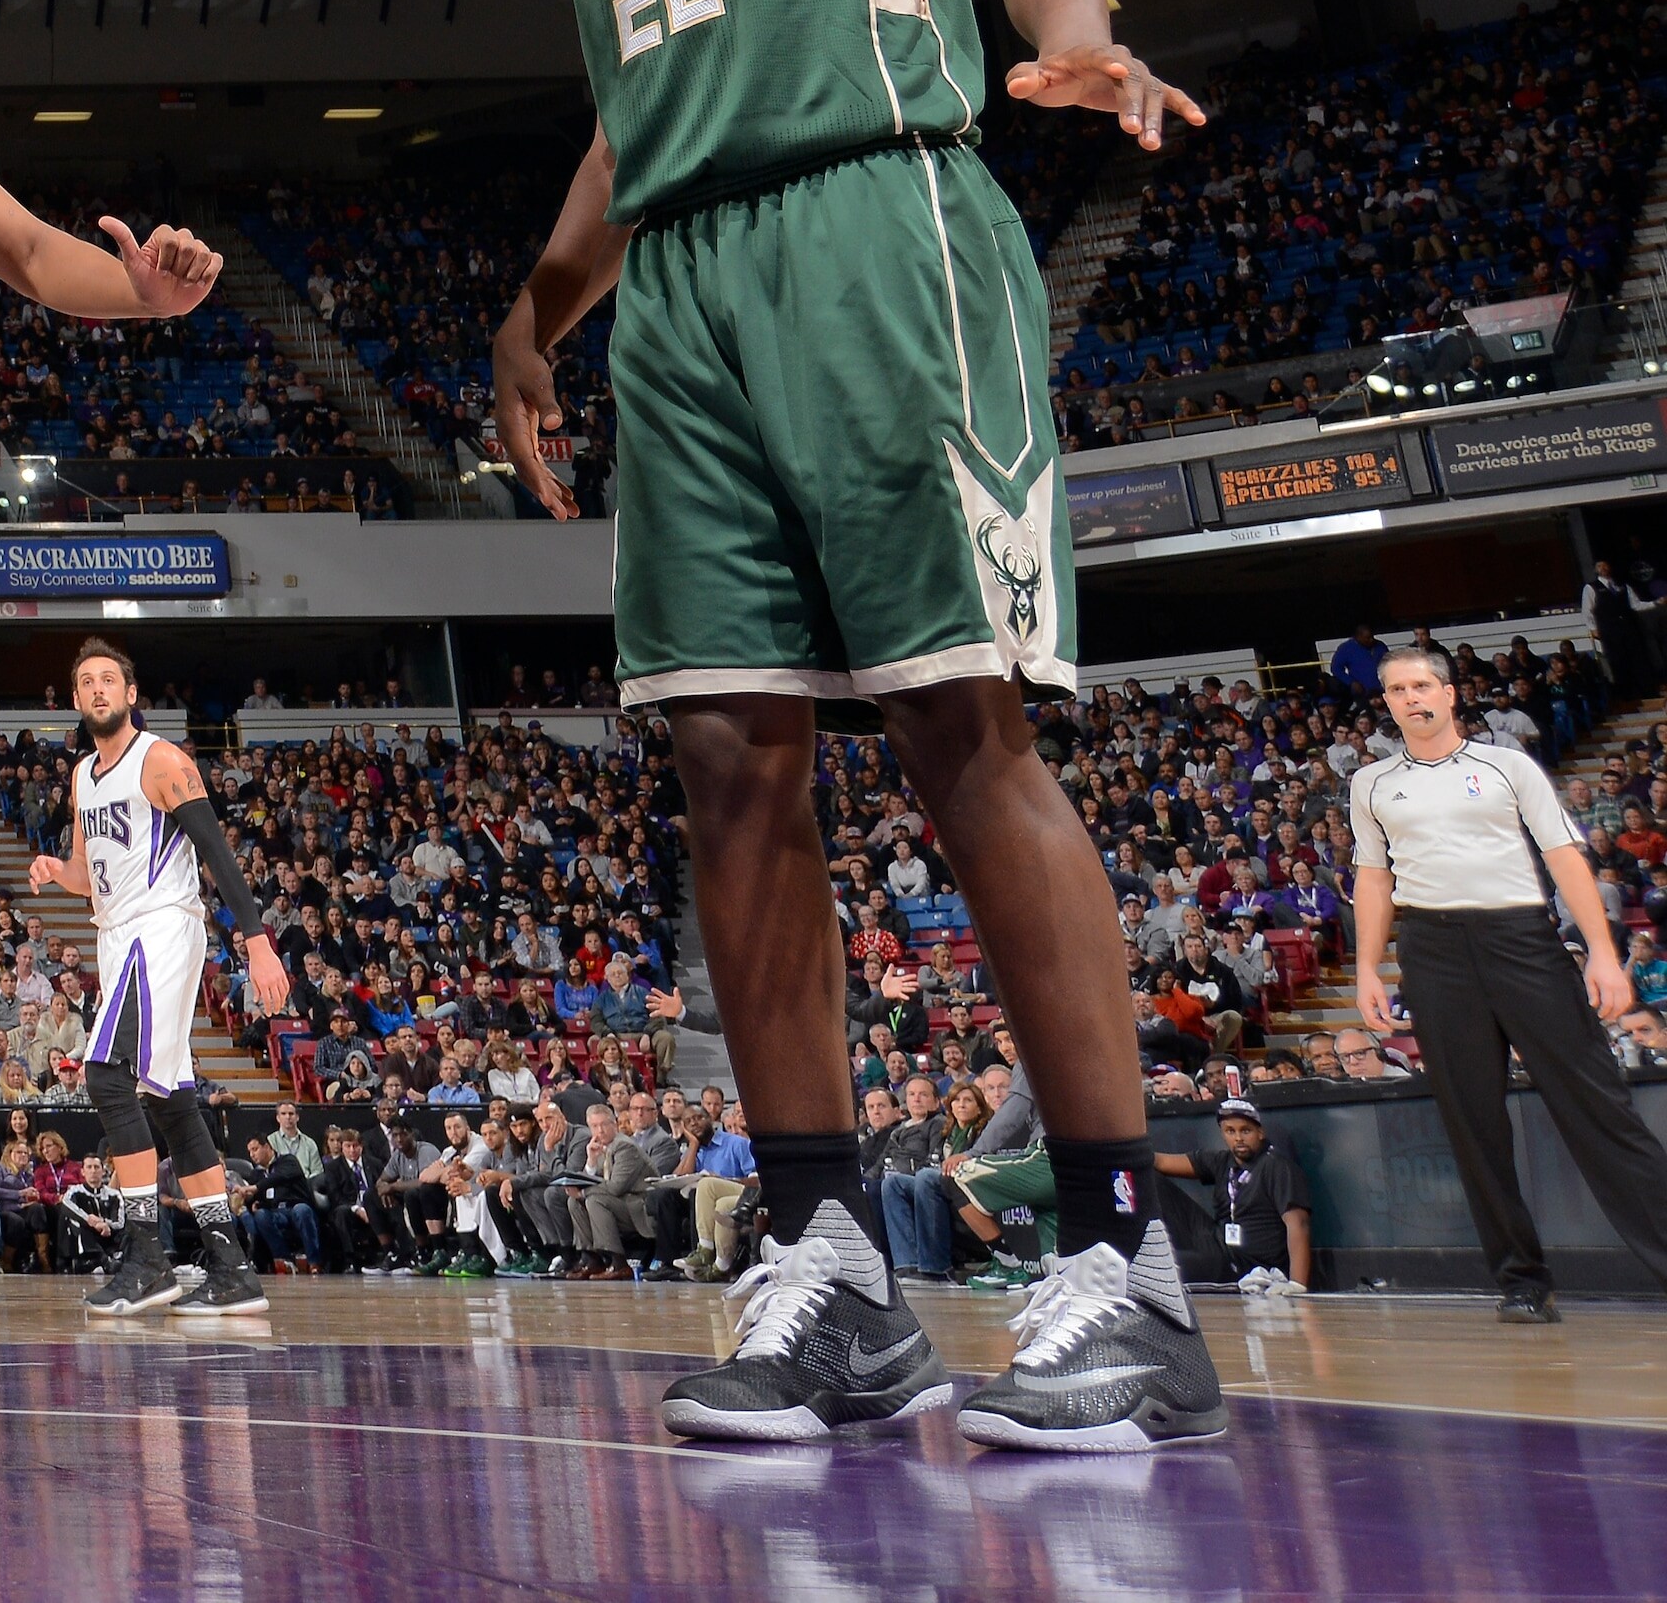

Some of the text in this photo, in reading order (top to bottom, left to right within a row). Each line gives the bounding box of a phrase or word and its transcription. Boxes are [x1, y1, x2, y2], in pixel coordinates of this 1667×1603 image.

[1449, 436, 1657, 474] services fit for the Kings
[1455, 421, 1653, 458] Data, voice and storage
[1235, 458, 1339, 486] GRIZZLIES
[1345, 452, 1377, 471] 110
[1092, 480, 1167, 501] up your business!
[1237, 470, 1383, 503] PELICANS 95
[1230, 526, 1281, 542] Suite H
[8, 545, 164, 571] SACRAMENTO
[167, 544, 215, 569] BEE
[10, 571, 217, 589] Stay Connected sacbee.com
[187, 602, 211, 613] Suite
[78, 799, 132, 852] INGS
[92, 859, 113, 896] 3
